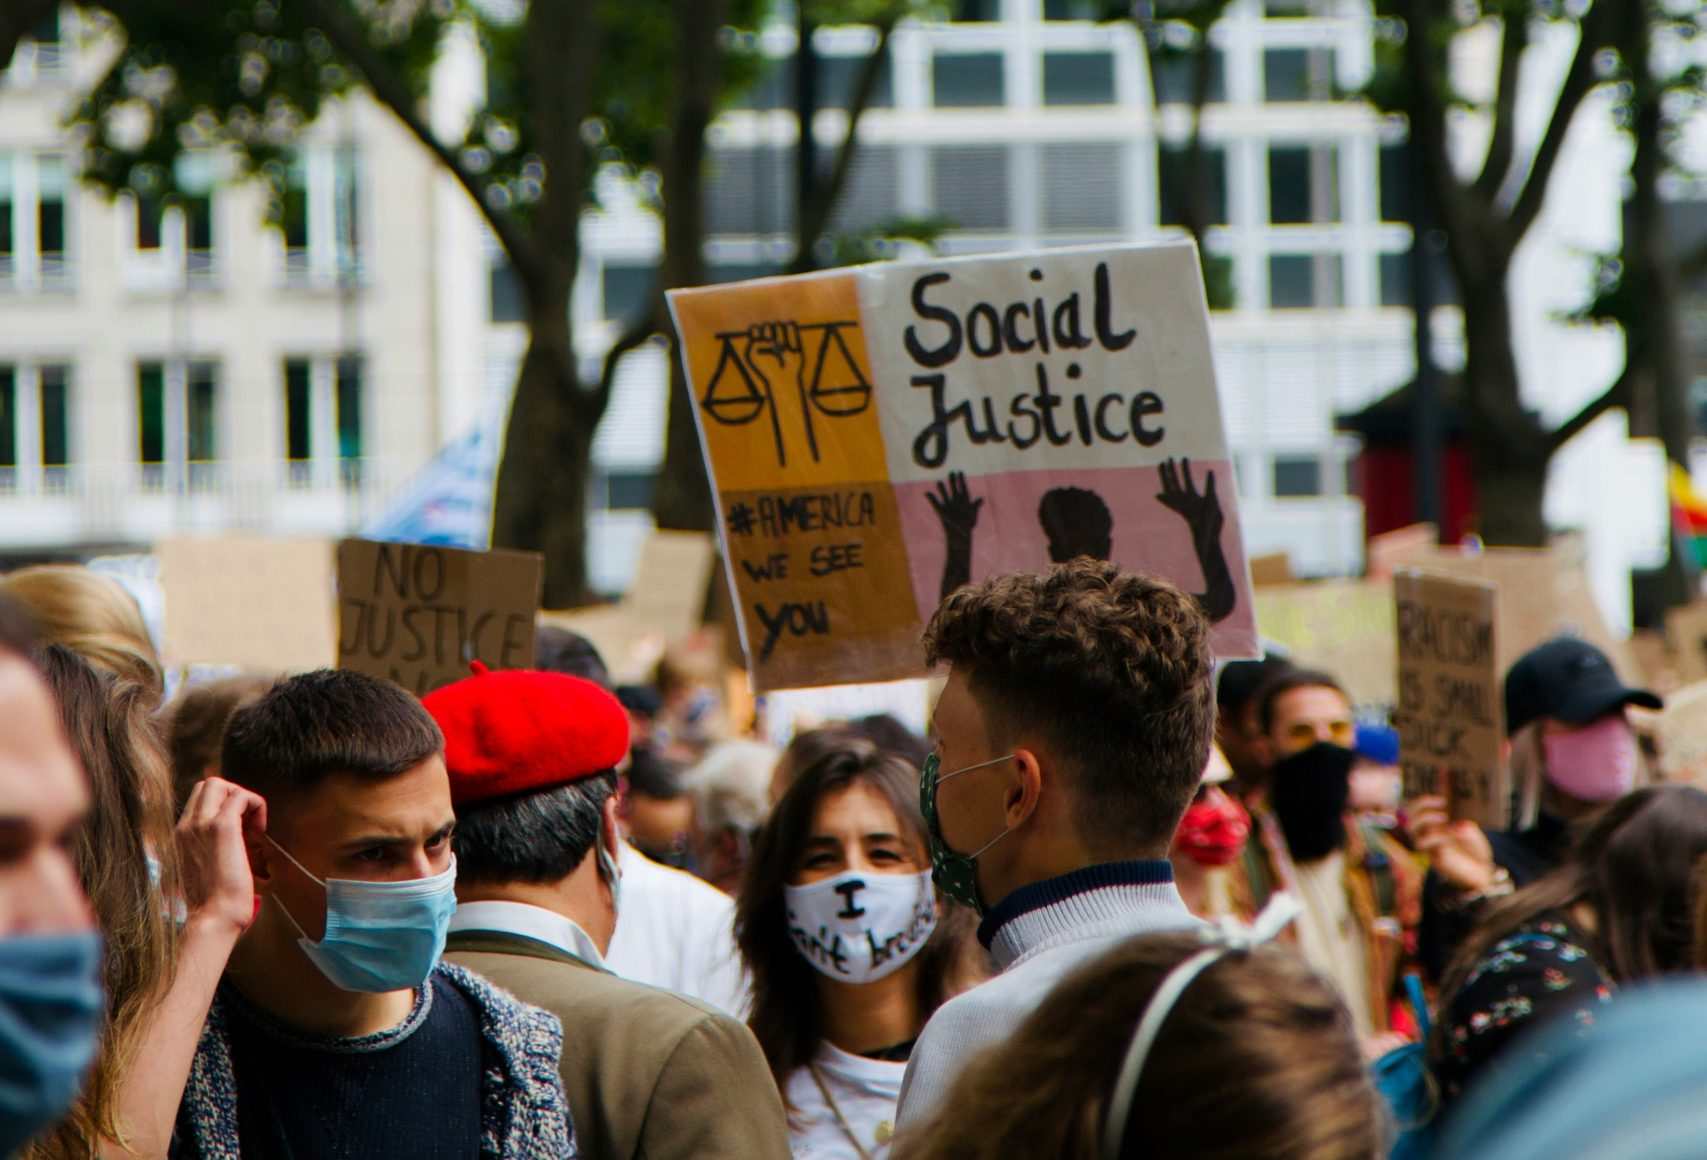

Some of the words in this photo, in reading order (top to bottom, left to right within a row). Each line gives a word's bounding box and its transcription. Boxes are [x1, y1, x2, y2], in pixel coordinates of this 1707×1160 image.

[904, 262, 1137, 368] Social
[910, 362, 1165, 469] Justice
[728, 492, 875, 536] #AMERICA
[374, 543, 447, 602] NO
[741, 553, 790, 583] WE
[809, 543, 864, 577] SEE
[340, 597, 527, 669] JUSTICE
[834, 879, 865, 919] I
